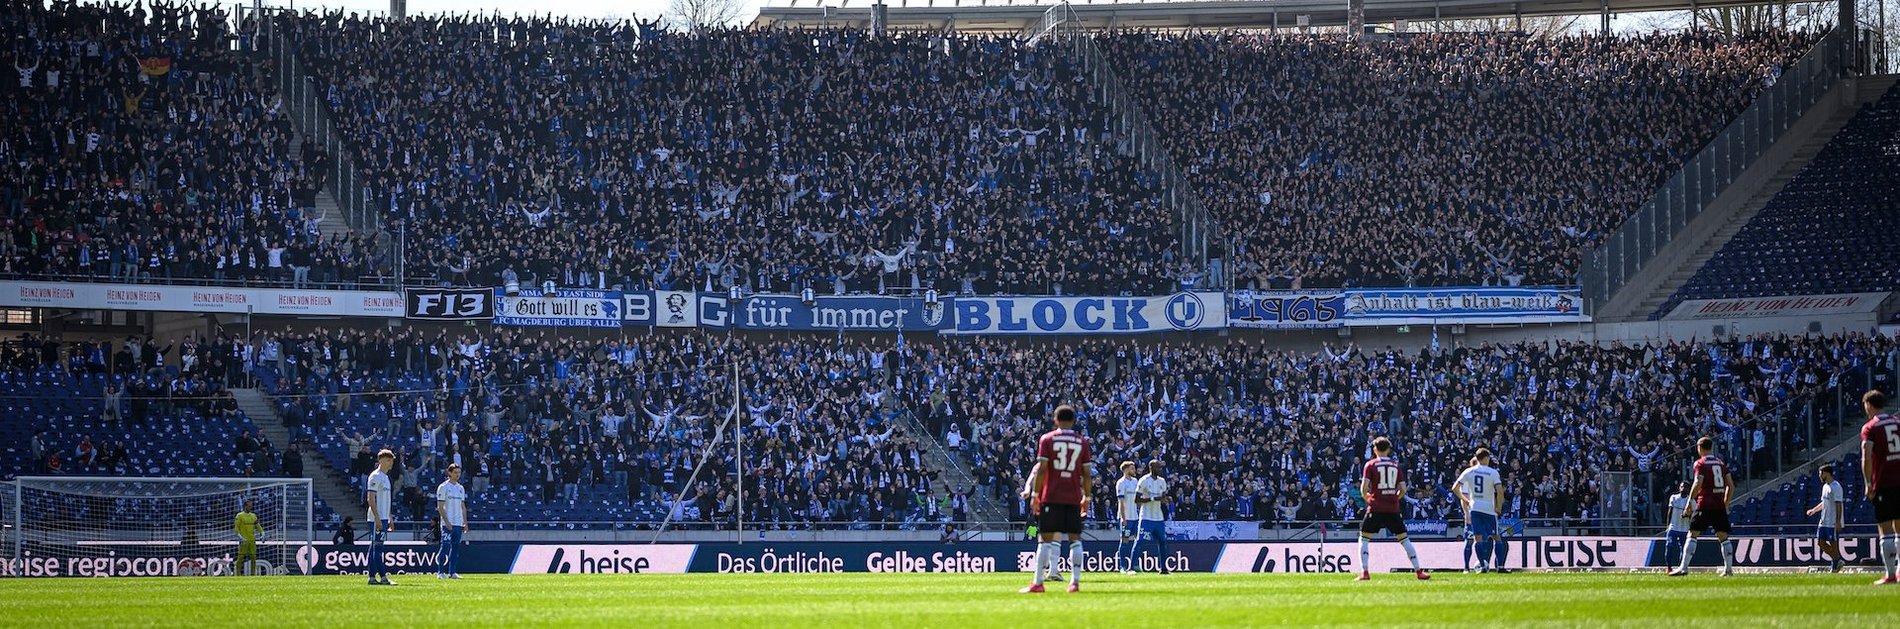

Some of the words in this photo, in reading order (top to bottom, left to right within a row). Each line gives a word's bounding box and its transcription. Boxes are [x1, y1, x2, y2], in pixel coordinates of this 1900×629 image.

[20, 286, 38, 298] HEINZ
[52, 287, 75, 299] HEIDEN
[107, 289, 125, 300] HEINZ
[139, 290, 161, 301] HEIDEN
[193, 291, 211, 303] HEINZ
[224, 292, 247, 304] HEIDEN
[278, 294, 296, 305] HEINZ
[310, 295, 332, 306] HEIDEN
[363, 296, 381, 307] HEINZ
[586, 291, 606, 299] SIDE
[1349, 292, 1418, 316] Anhalt
[1427, 292, 1453, 311] ist
[1461, 292, 1553, 310] blau-weiß
[516, 298, 547, 315] Gott
[551, 299, 578, 316] will
[584, 303, 598, 317] es
[624, 293, 650, 321] B
[700, 294, 728, 326] G
[745, 298, 792, 328] für
[810, 301, 908, 329] immer
[955, 299, 1150, 332] BLOCK
[1240, 295, 1337, 322] 1965
[1699, 300, 1751, 314] HEINZ
[1753, 299, 1791, 311] VON
[1790, 296, 1860, 310] HEIDEN
[512, 318, 567, 326] MAGDEBURG
[593, 319, 621, 327] ALLES
[1885, 424, 1900, 453] 5
[1053, 442, 1082, 471] 37
[1377, 466, 1399, 489] 10
[1474, 475, 1484, 493] 9
[1712, 465, 1725, 488] 8
[325, 549, 449, 570] gewsstwo
[579, 549, 649, 574] heise
[718, 552, 756, 573] Das
[760, 547, 844, 573] Örtliche
[867, 551, 928, 573] Gelbe
[932, 551, 996, 573] Seiten
[1284, 548, 1352, 573] heise
